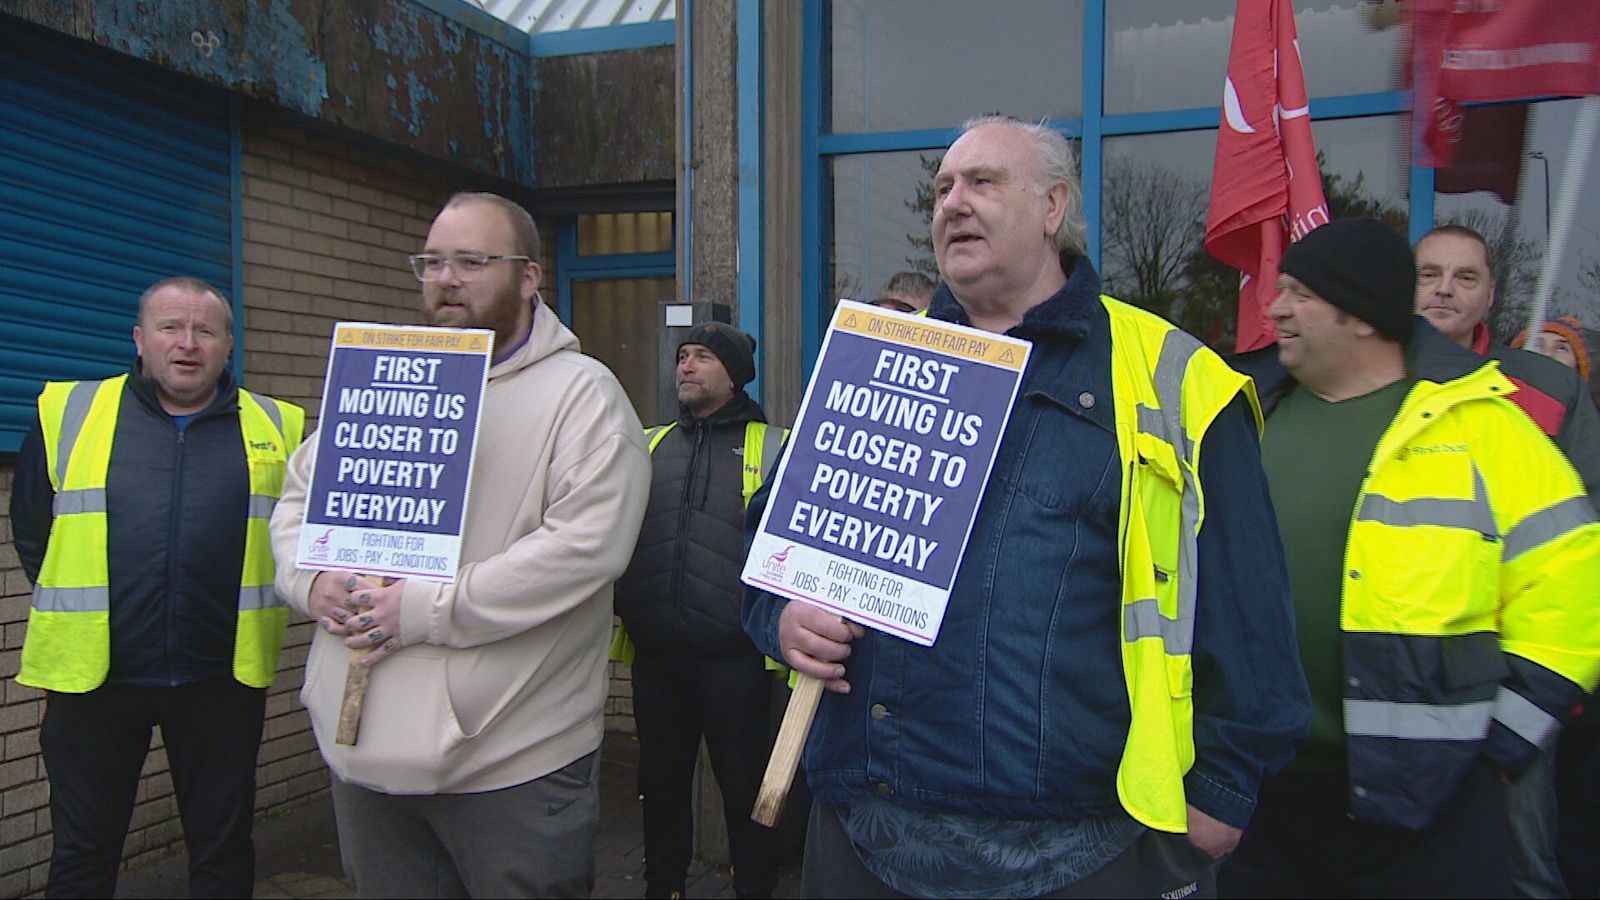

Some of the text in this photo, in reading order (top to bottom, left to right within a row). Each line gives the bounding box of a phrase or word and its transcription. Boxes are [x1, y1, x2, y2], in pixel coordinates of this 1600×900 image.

[363, 332, 461, 348] ON STRIKE FOR FAIR PAY
[868, 318, 990, 357] ON STRIKE FOR FAIR PAY
[373, 355, 442, 384] FIRST
[873, 348, 960, 395] FIRST
[338, 388, 466, 420] MOVING US
[824, 380, 984, 447] MOVING US
[334, 422, 459, 455] CLOSER TO
[814, 420, 968, 489] CLOSER TO
[336, 456, 445, 489] POVERTY
[325, 491, 446, 526] EVERYDAY
[809, 462, 944, 527] POVERTY
[361, 532, 425, 551] FIGHTING FOR
[788, 500, 939, 572] EVERYDAY
[334, 548, 358, 563] JOBS
[364, 550, 384, 565] PAY
[391, 552, 448, 571] CONDITIONS
[762, 559, 786, 575] unite
[826, 560, 904, 599] FIGHTING FOR
[791, 570, 820, 593] JOBS
[827, 582, 851, 603] PAY
[858, 592, 929, 630] CONDITIONS
